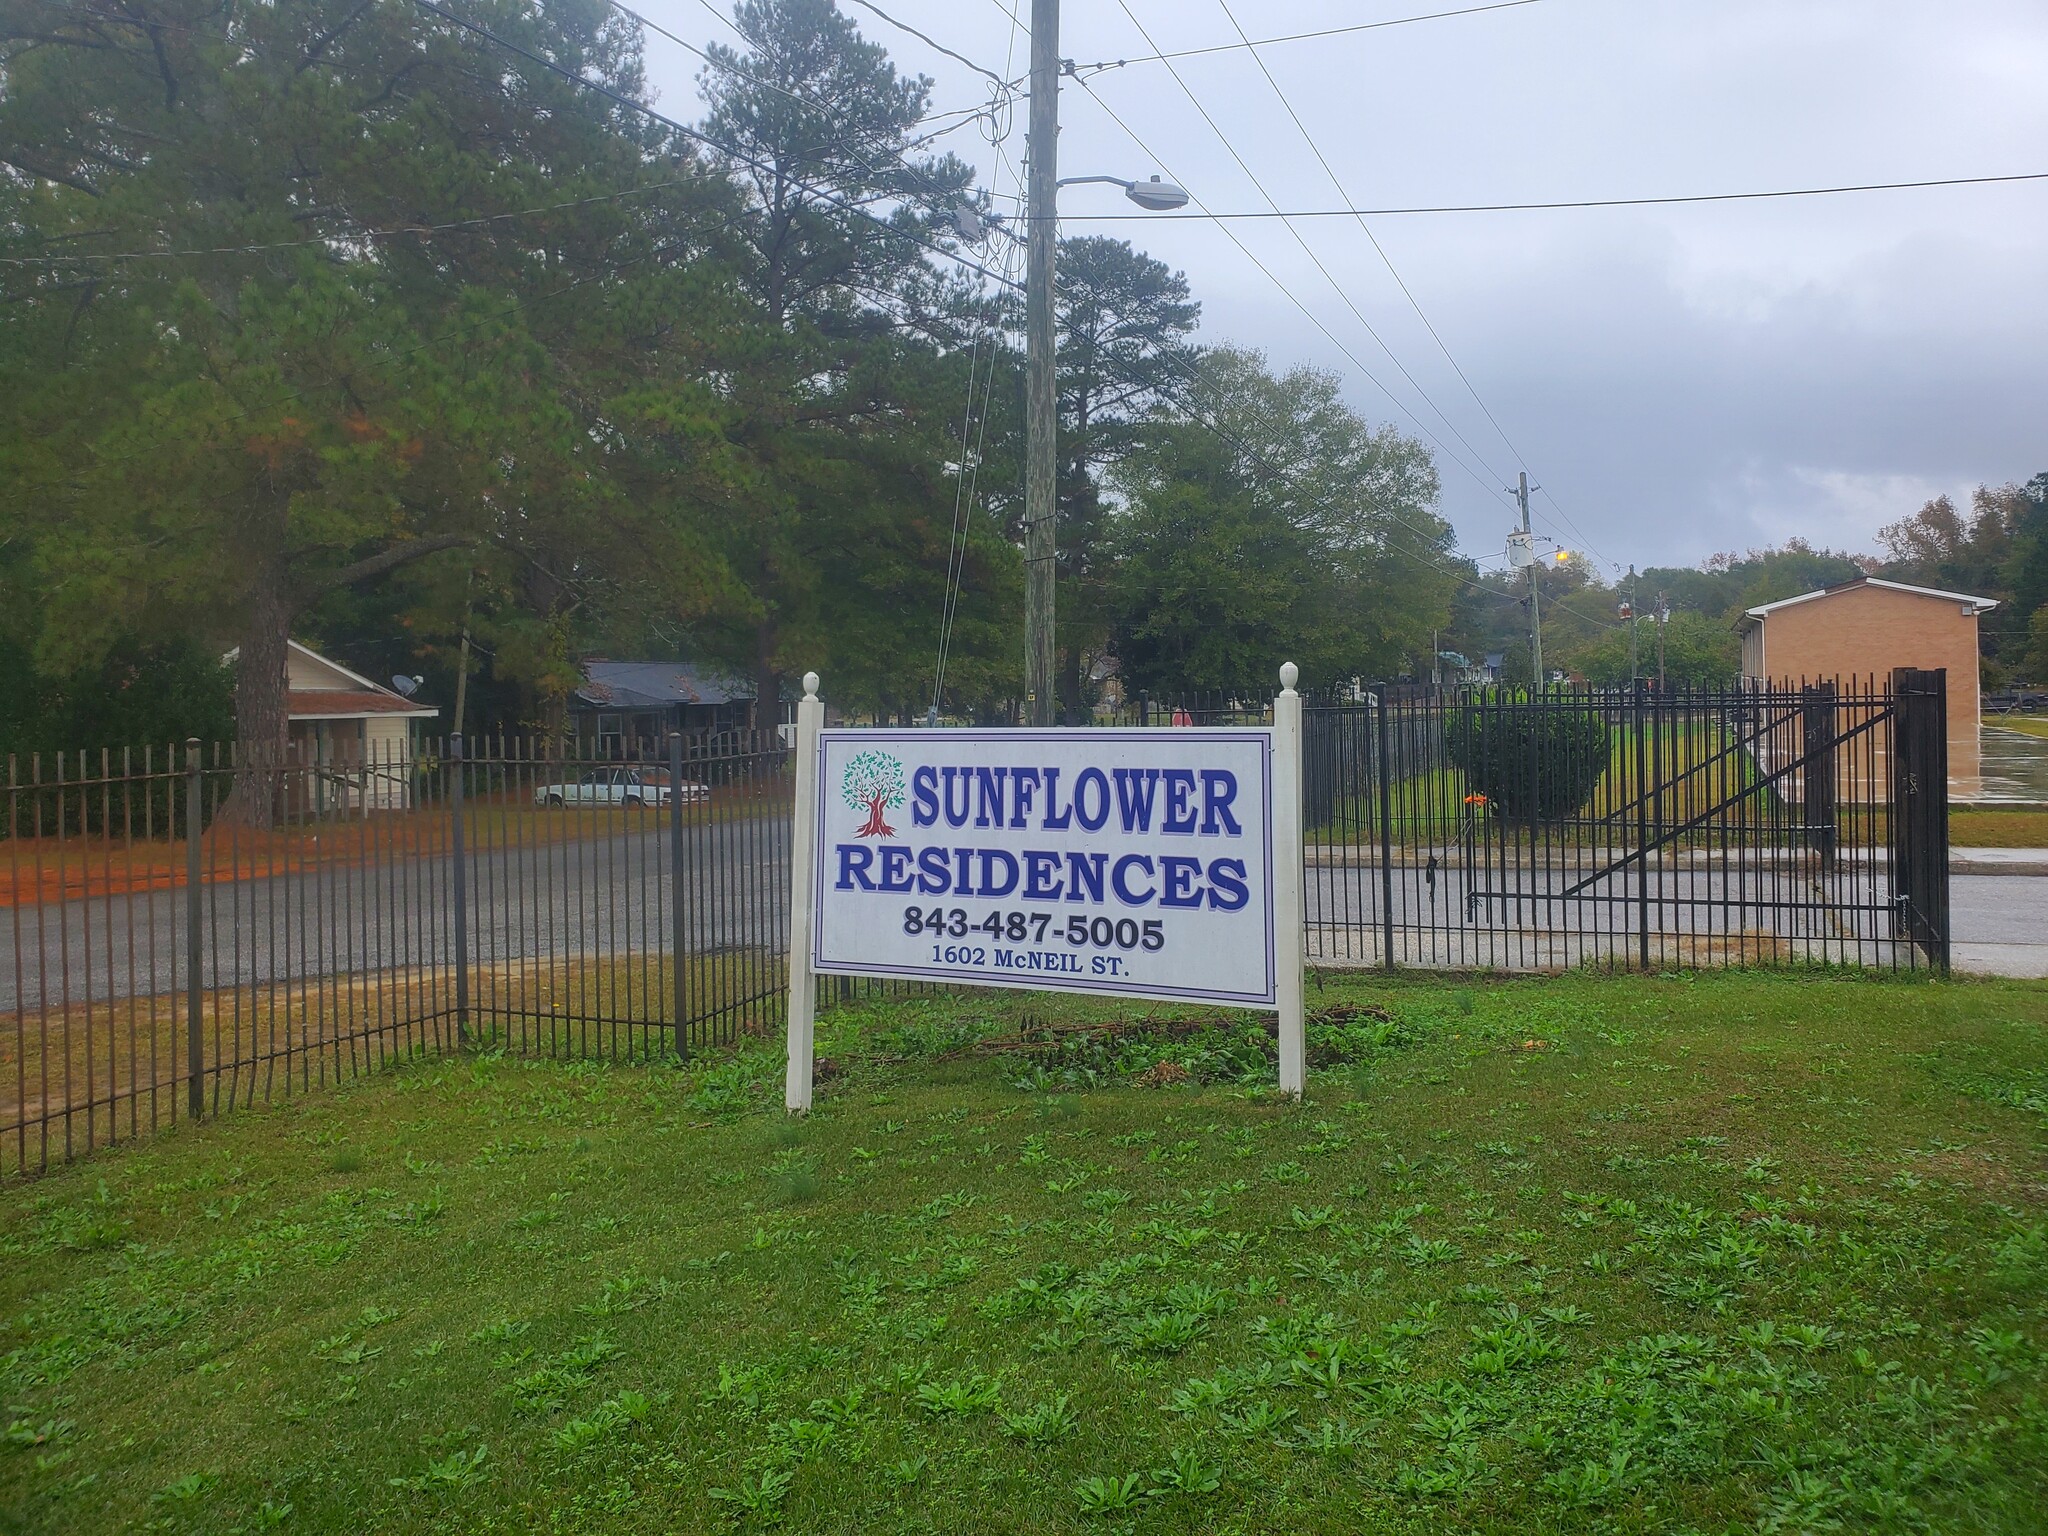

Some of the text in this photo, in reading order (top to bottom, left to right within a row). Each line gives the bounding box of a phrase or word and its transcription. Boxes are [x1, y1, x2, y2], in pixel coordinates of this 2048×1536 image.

[911, 765, 1243, 836] SUNFLOWER
[834, 843, 1250, 912] RESIDENCES
[903, 905, 1165, 951] 843-487-5005
[932, 944, 1131, 978] 1602 McNEIL ST.
